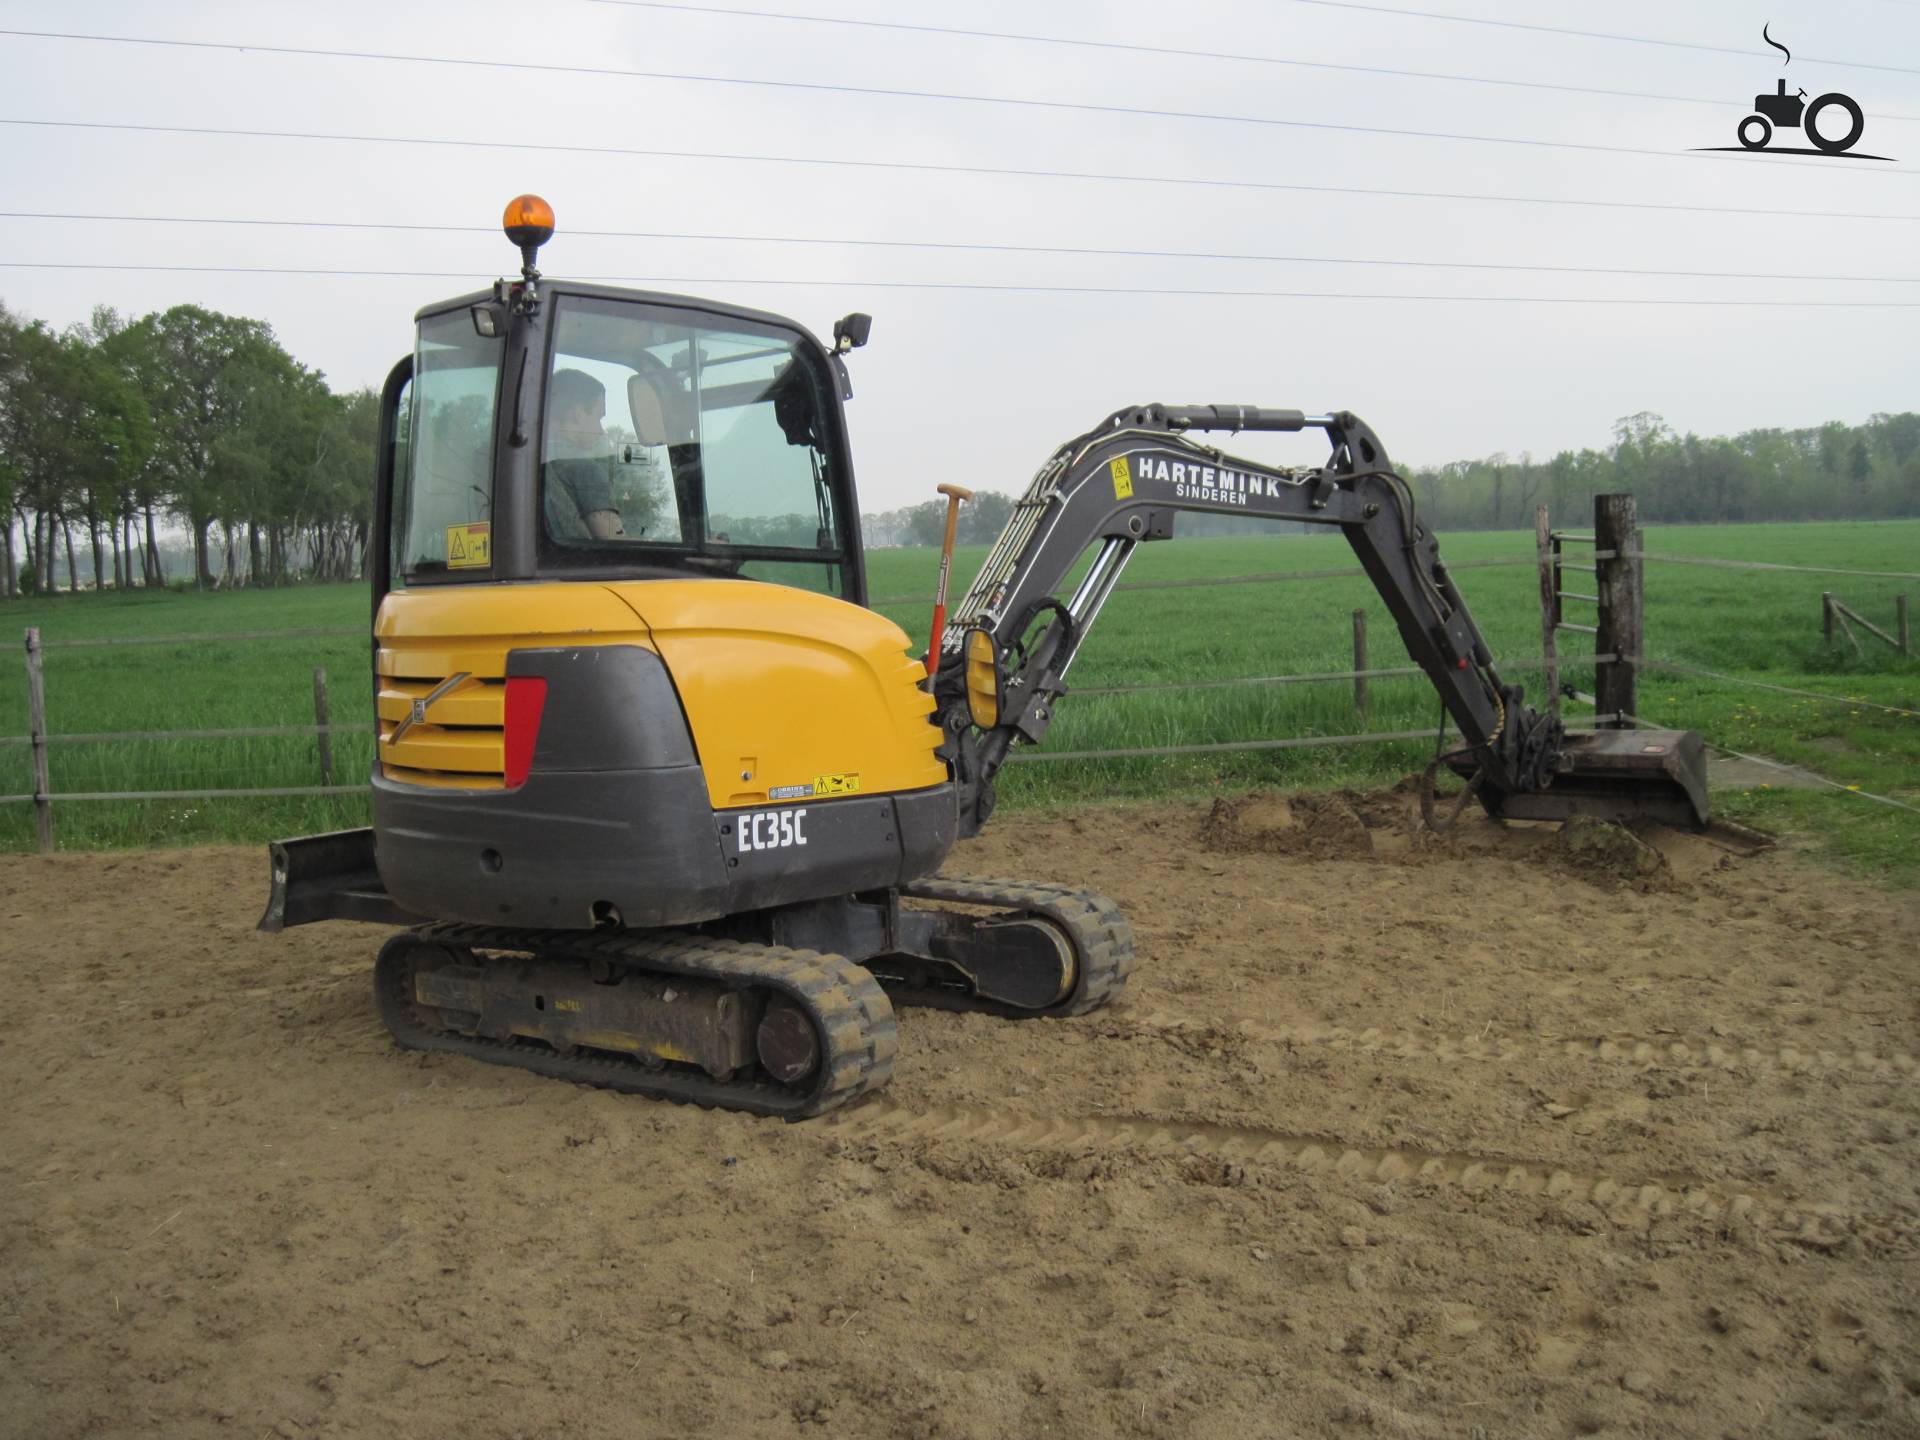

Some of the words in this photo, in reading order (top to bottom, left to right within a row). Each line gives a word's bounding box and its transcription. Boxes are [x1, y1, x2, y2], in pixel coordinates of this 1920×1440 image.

[1139, 458, 1280, 497] HARTEMINK
[1176, 484, 1247, 505] SINDEREN
[738, 809, 807, 852] EC35C
